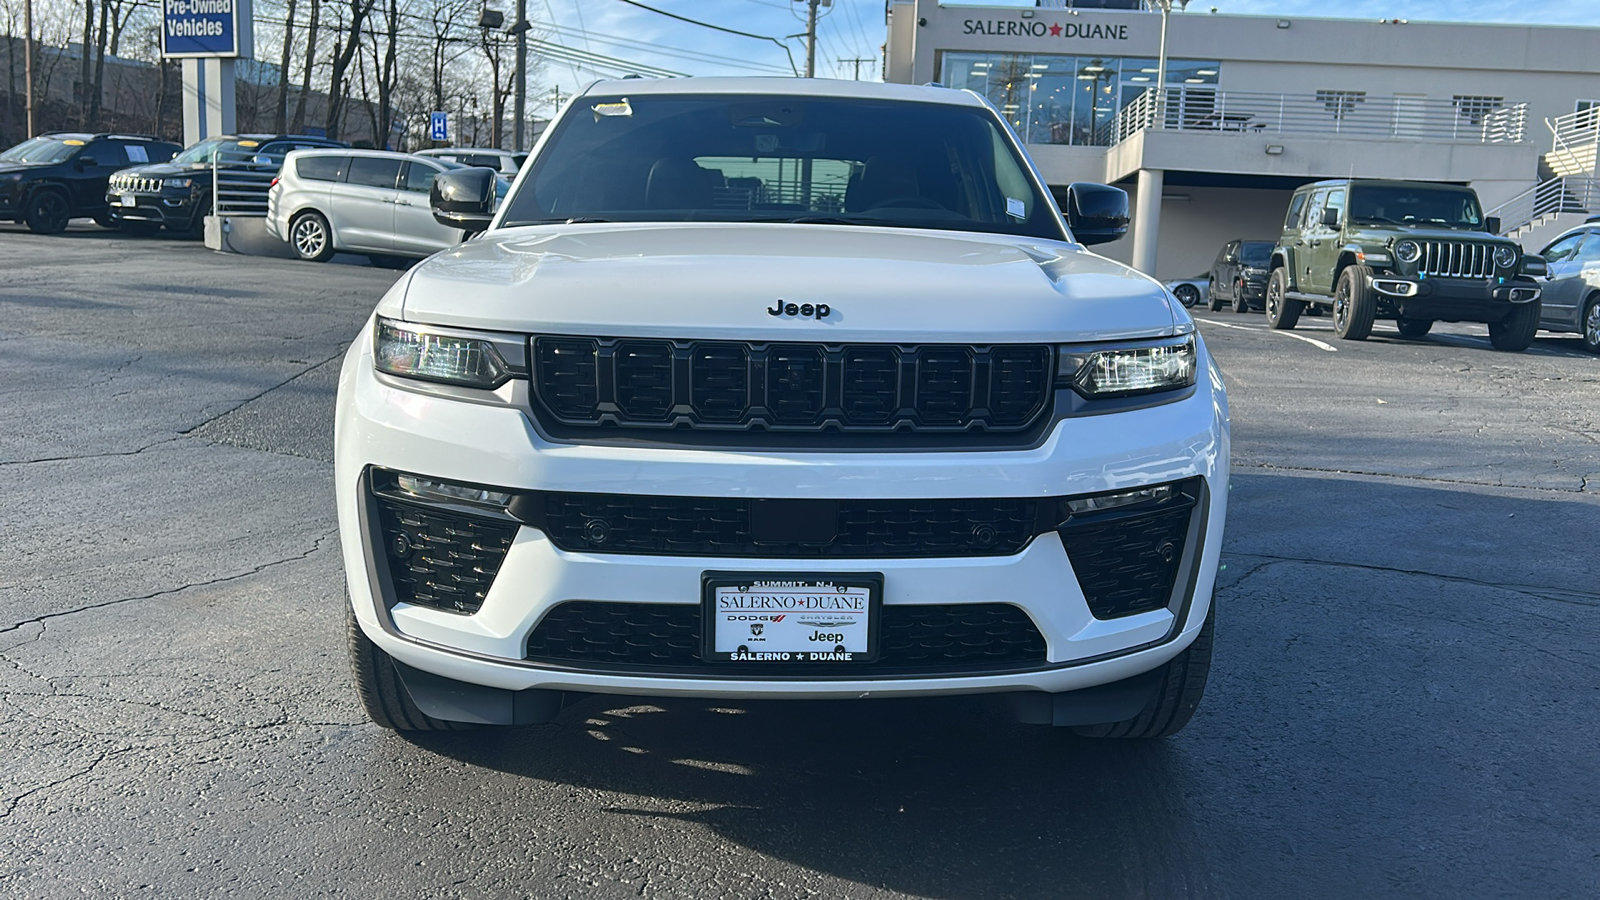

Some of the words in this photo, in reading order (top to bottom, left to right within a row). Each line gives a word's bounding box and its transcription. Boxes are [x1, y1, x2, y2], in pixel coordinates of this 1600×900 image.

[166, 0, 231, 15] Pre-Owned
[167, 18, 223, 37] Vehicles
[963, 19, 1047, 37] SALERNO
[1065, 23, 1128, 40] DUANE
[434, 118, 444, 132] H
[766, 299, 831, 320] Jeep
[720, 595, 796, 609] SALERNO
[806, 596, 864, 610] DUANE
[808, 630, 844, 643] Jeep
[730, 652, 790, 661] SALERNO
[810, 652, 853, 661] DUANE
